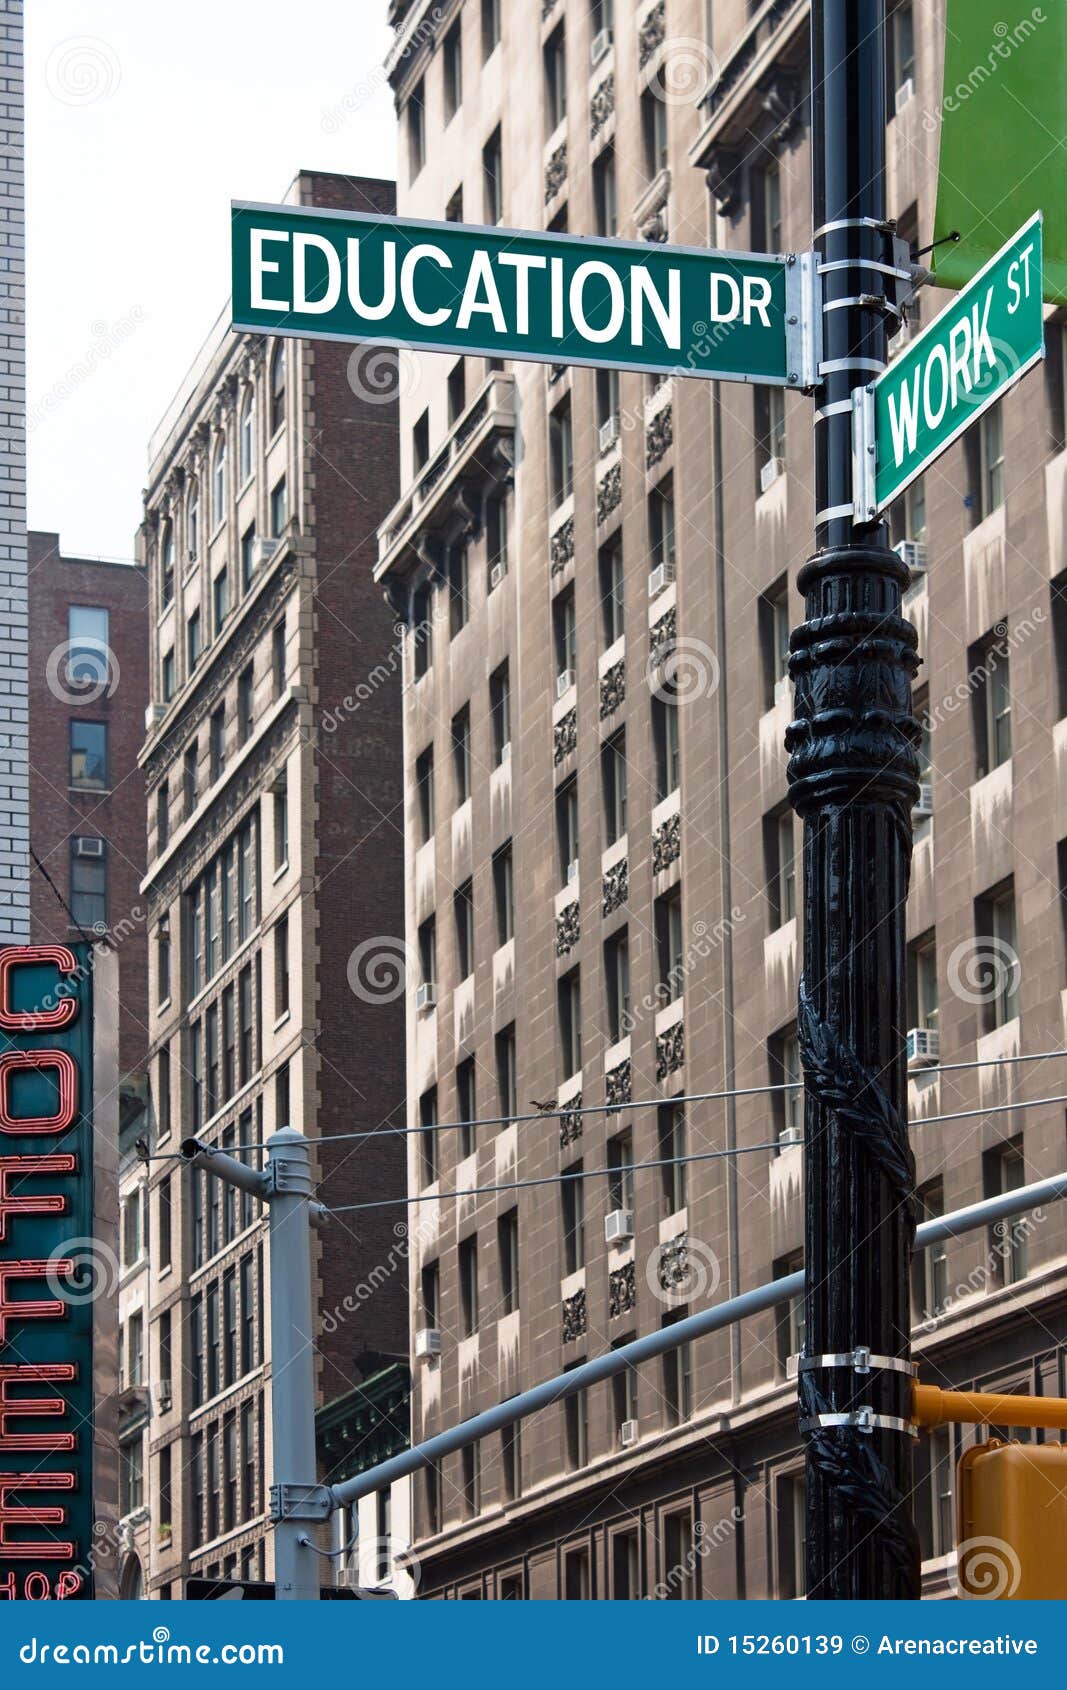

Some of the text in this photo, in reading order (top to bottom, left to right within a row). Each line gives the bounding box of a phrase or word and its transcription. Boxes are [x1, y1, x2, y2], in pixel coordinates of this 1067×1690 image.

[250, 228, 772, 350] EDUCATION DR
[887, 242, 1034, 469] WORK ST
[0, 945, 77, 1559] COFFEE
